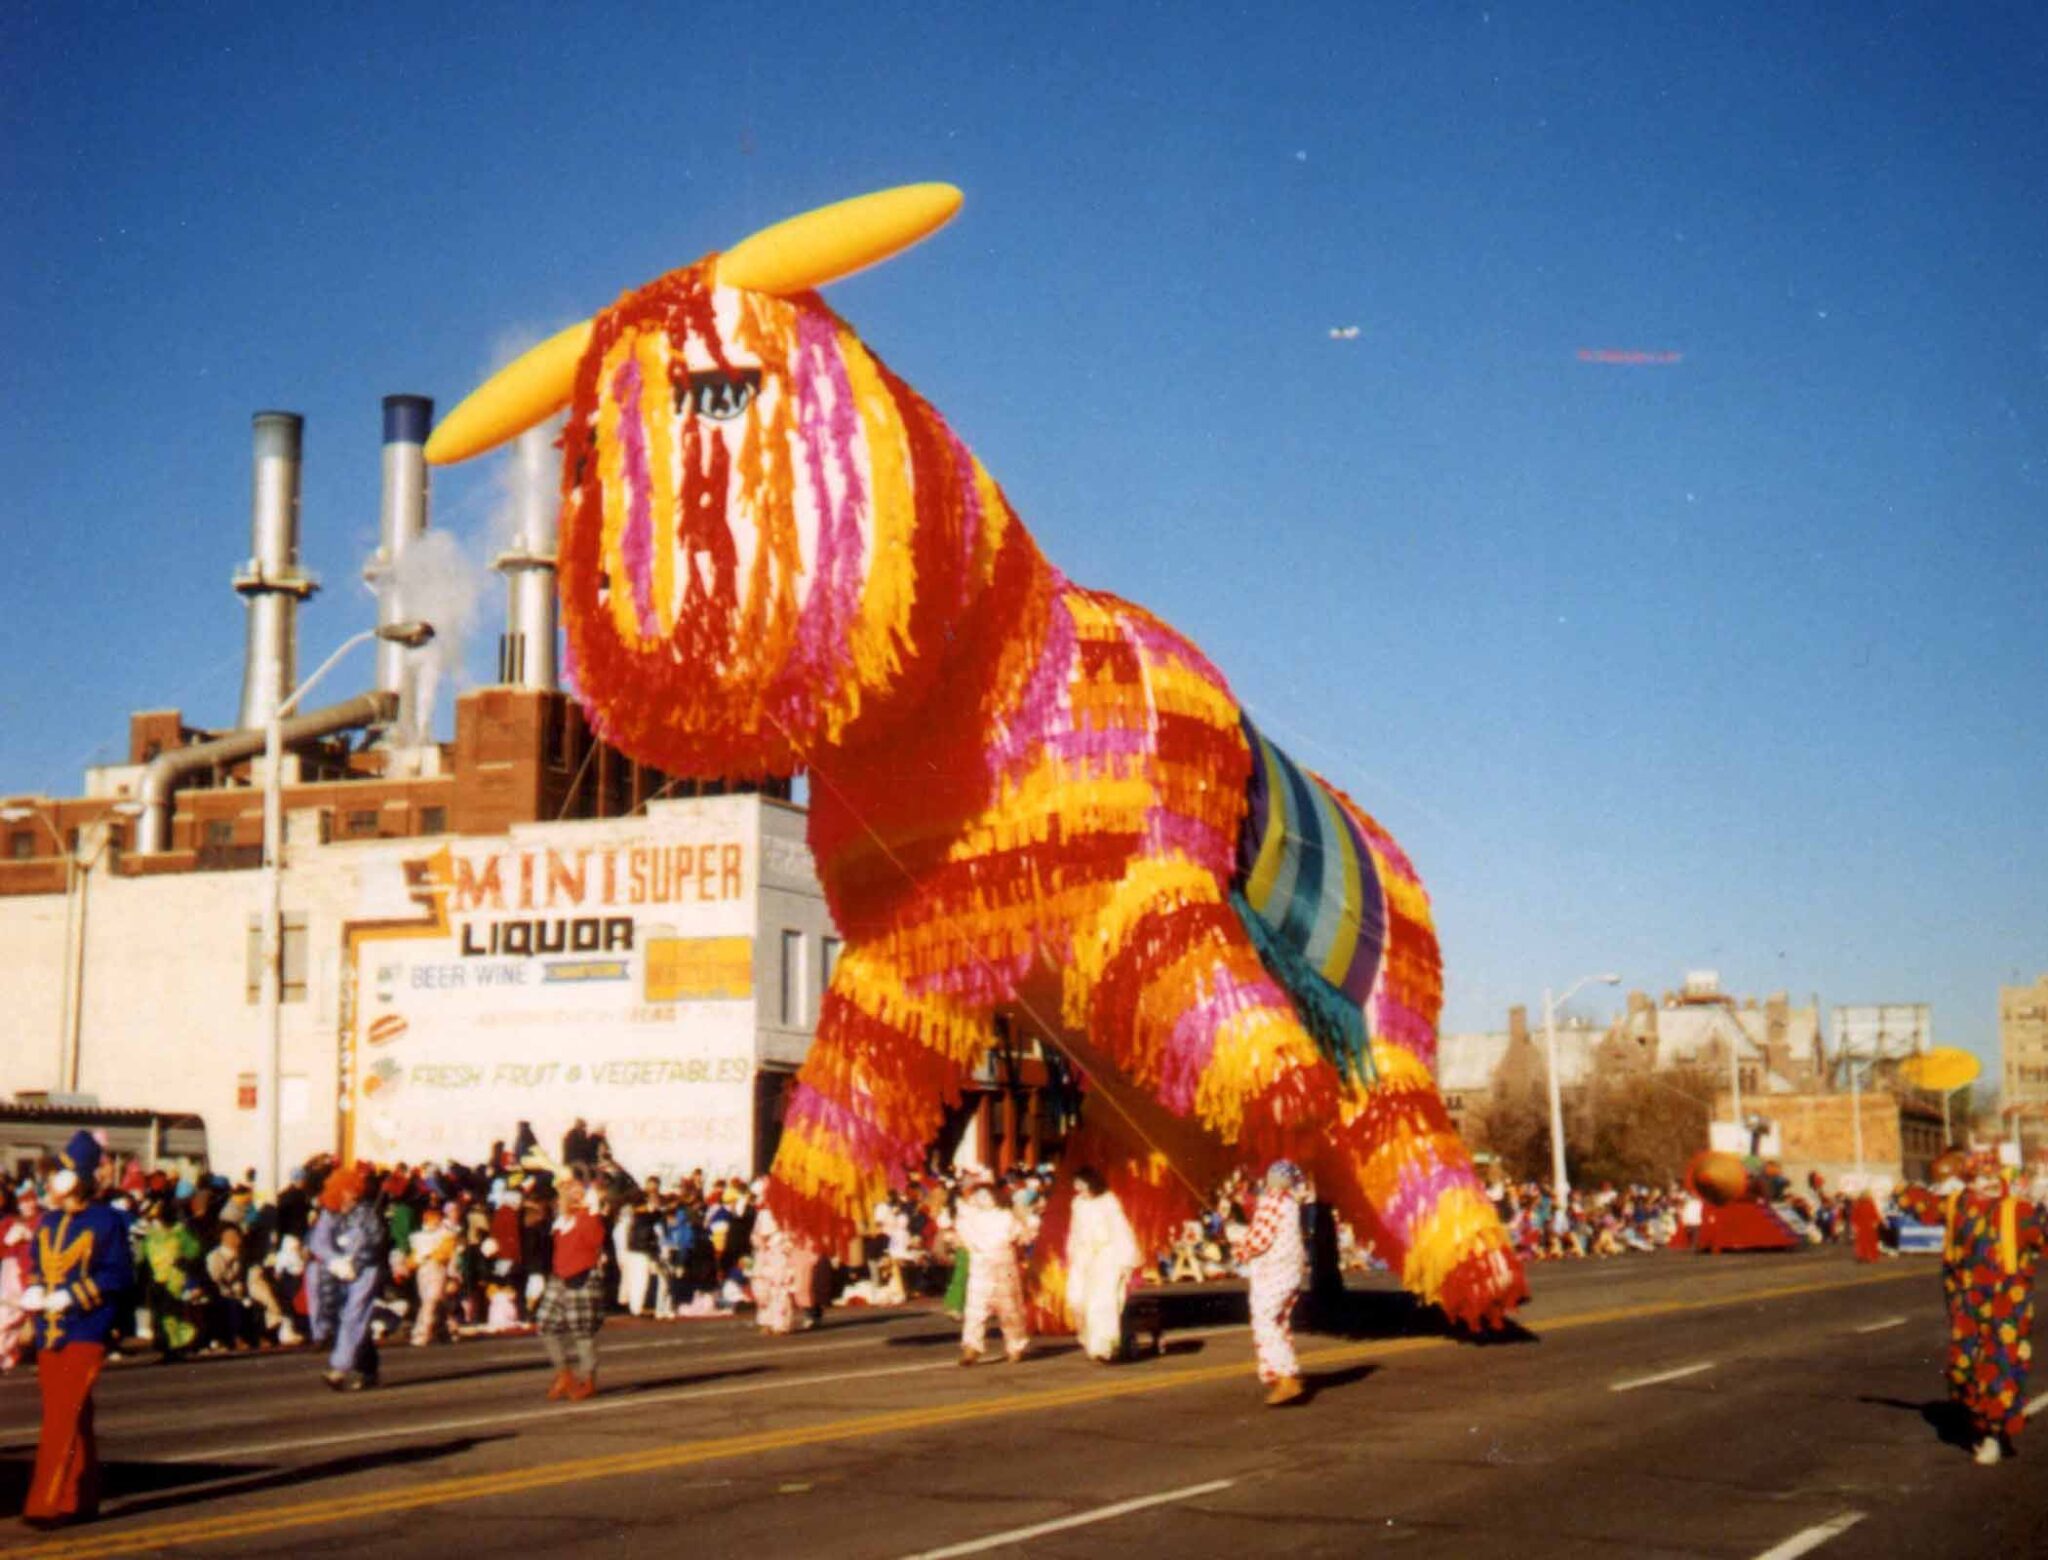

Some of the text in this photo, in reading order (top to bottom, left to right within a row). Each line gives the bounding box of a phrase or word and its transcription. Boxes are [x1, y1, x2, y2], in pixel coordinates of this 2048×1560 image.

[456, 844, 742, 909] MINI SUPER
[461, 917, 634, 957] LIQUOR
[411, 965, 466, 988] BEER
[475, 963, 528, 986] WINE
[410, 1063, 483, 1088] FRESH
[491, 1061, 561, 1087] FRUIT
[591, 1058, 749, 1085] VEGETABLES
